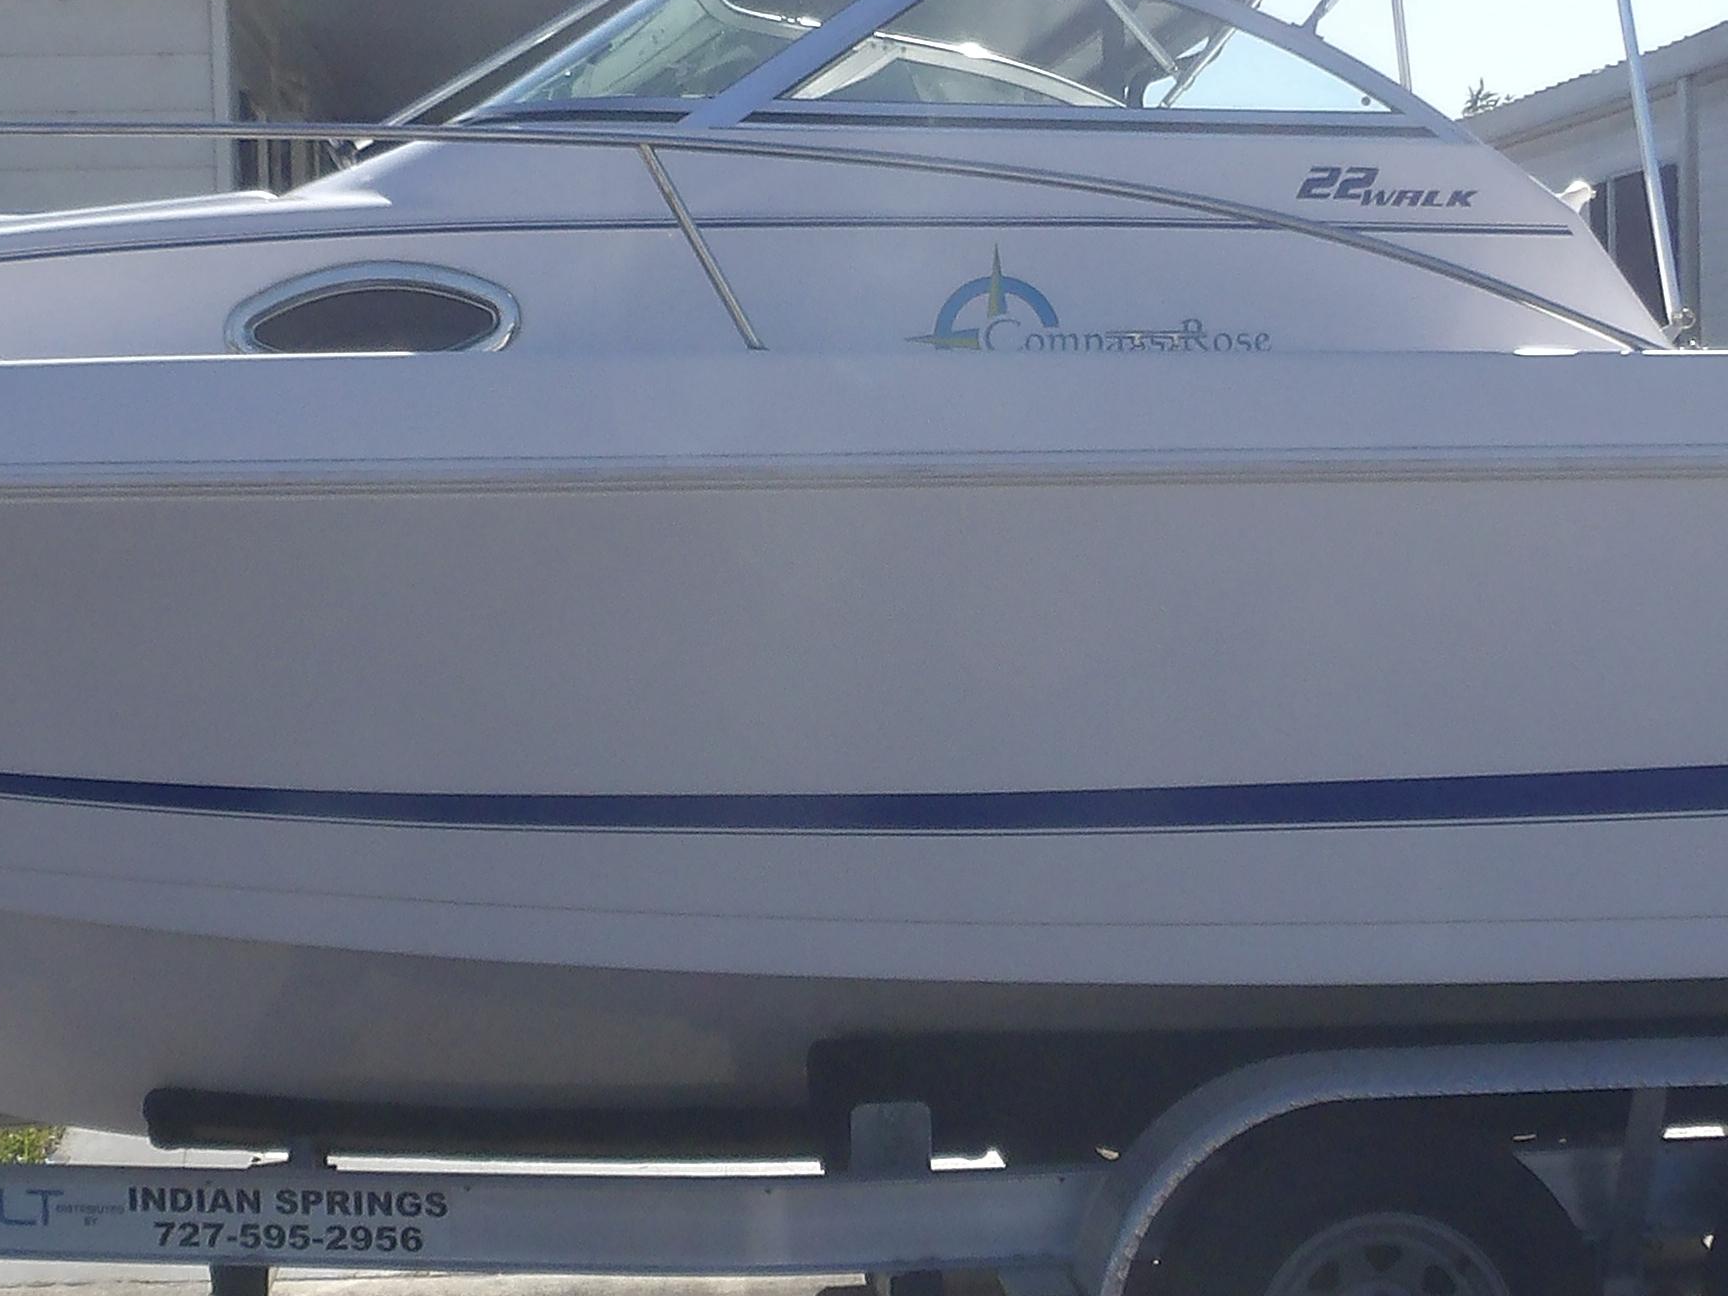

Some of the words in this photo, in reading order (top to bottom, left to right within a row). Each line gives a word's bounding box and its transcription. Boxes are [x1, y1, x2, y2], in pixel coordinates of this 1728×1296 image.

[1295, 165, 1380, 200] 22
[1359, 188, 1479, 208] WALK
[128, 1186, 261, 1214] INDIAN
[275, 1190, 448, 1218] SPRINGS
[153, 1221, 425, 1253] 727-595-2956
